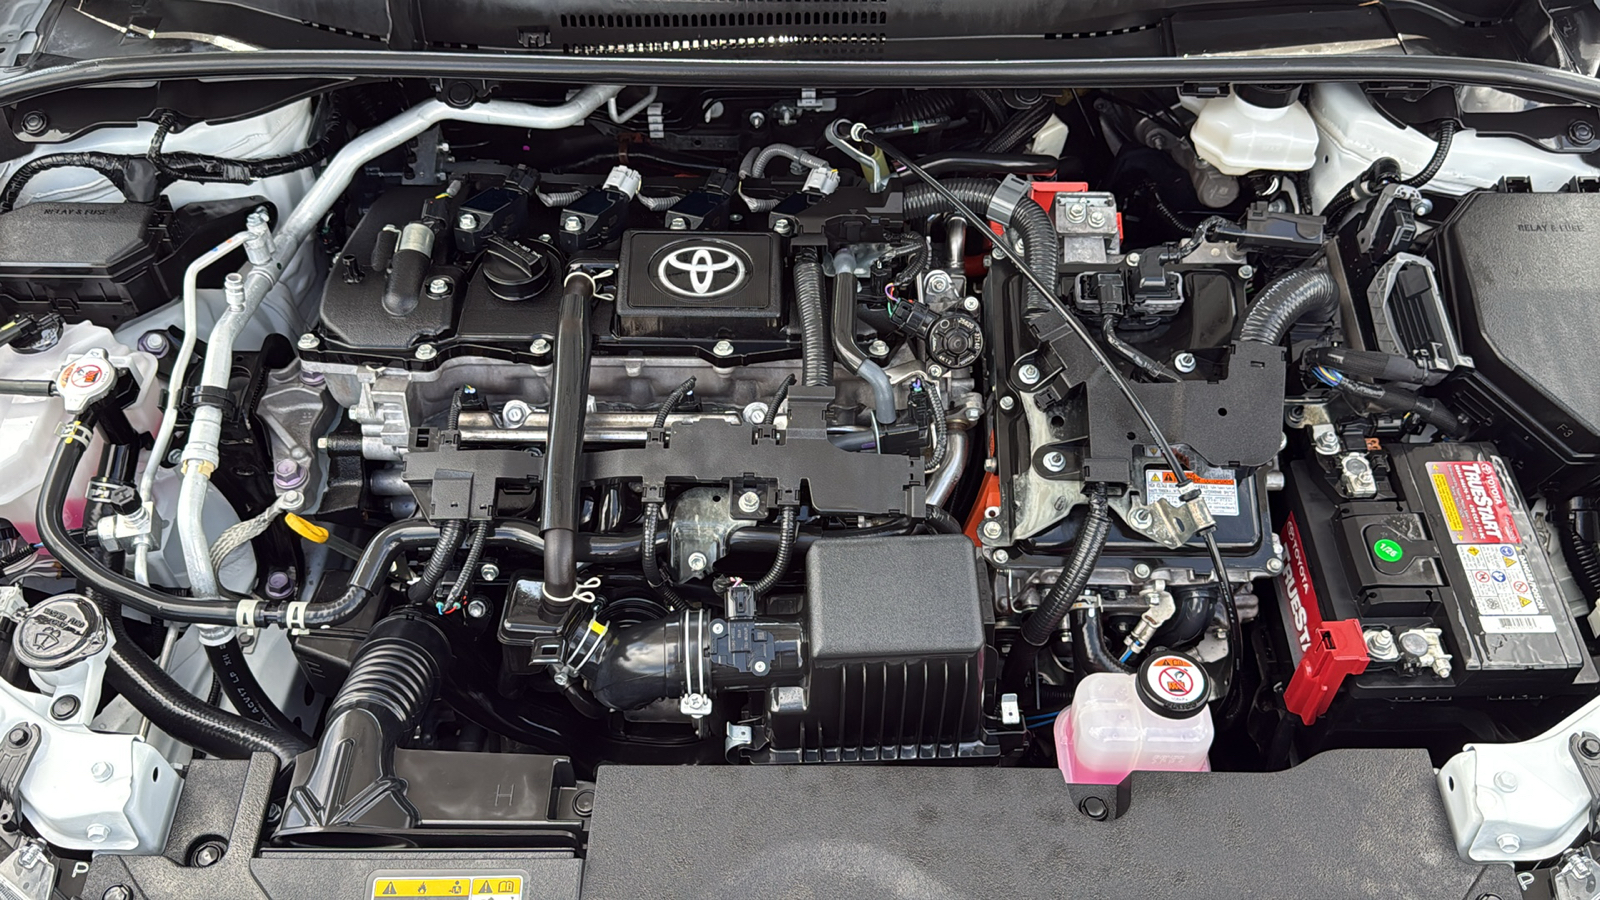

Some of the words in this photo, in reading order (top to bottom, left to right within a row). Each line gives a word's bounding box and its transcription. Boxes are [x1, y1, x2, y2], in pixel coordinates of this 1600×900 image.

[1517, 224, 1548, 232] RELAY
[1556, 423, 1574, 438] F3
[1484, 474, 1503, 505] TOYOTA
[1379, 542, 1398, 558] 1/26
[1292, 540, 1310, 595] TOYOTA
[237, 687, 260, 714] ACV17
[494, 784, 515, 807] H
[71, 861, 89, 878] P
[1516, 872, 1535, 891] P
